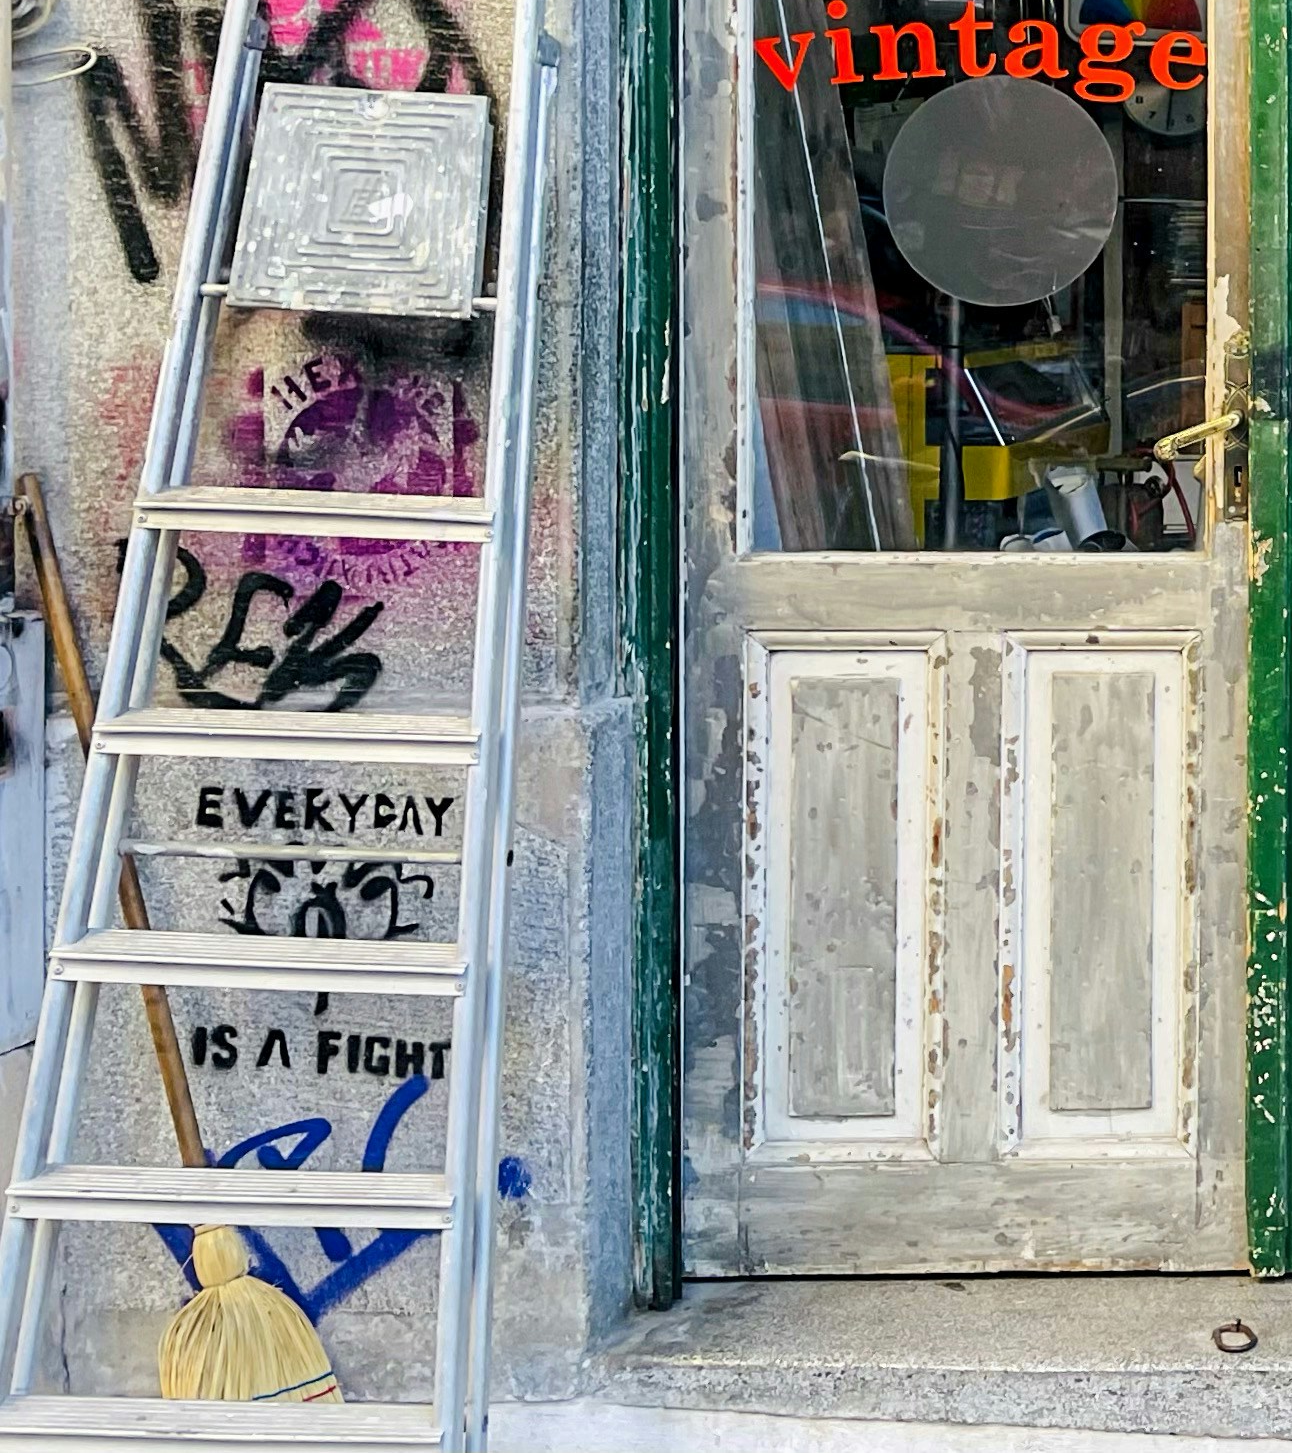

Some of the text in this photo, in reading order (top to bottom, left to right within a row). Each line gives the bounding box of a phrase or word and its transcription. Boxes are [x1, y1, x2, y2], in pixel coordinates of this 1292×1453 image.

[754, 0, 1207, 103] vintage
[195, 787, 455, 837] EVERYDAY
[191, 1024, 452, 1079] IS A FIGHT
